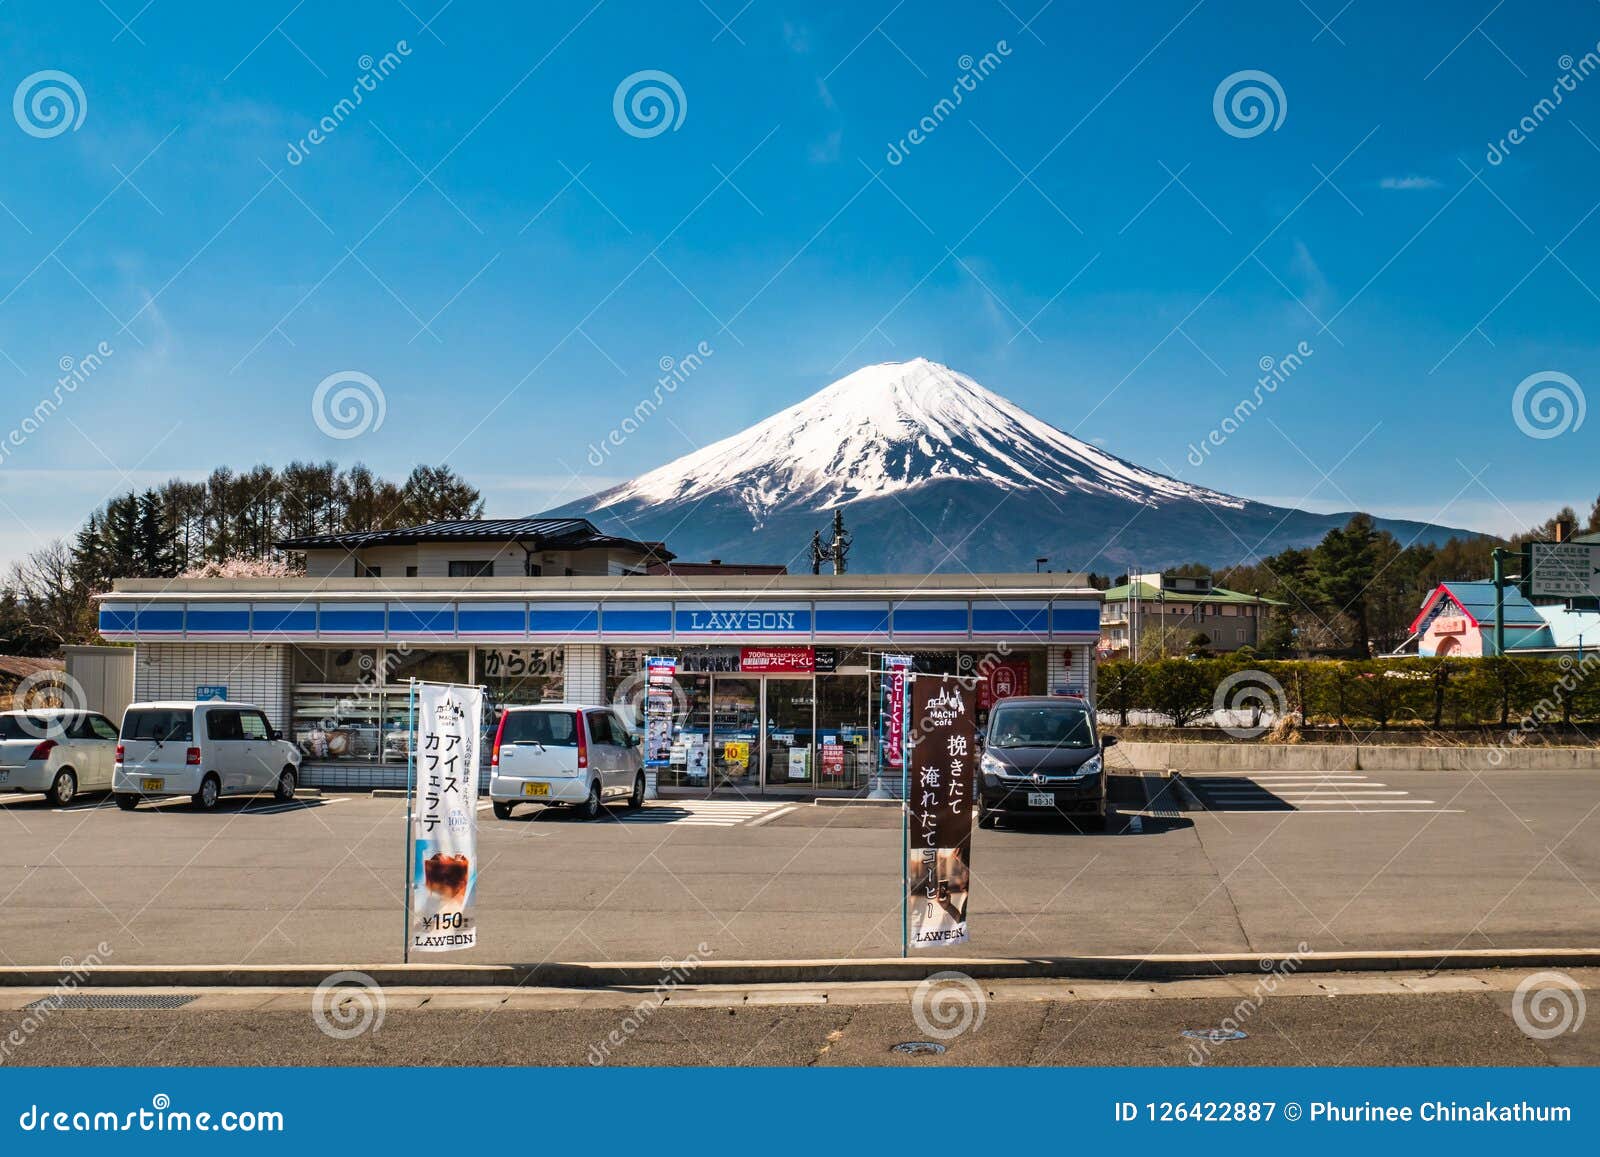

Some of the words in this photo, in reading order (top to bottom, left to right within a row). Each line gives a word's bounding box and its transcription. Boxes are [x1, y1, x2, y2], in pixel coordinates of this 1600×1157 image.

[691, 612, 795, 629] LAWSON
[770, 657, 813, 666] スピードくじ
[930, 711, 957, 720] MACHI
[935, 718, 953, 727] café
[725, 747, 738, 759] 10
[444, 733, 462, 793] アイス
[948, 734, 968, 814] 挽きたて
[424, 732, 441, 832] カフェラテ
[423, 912, 463, 930] ¥150
[415, 934, 473, 946] LAWSON
[916, 927, 965, 942] LAWSON
